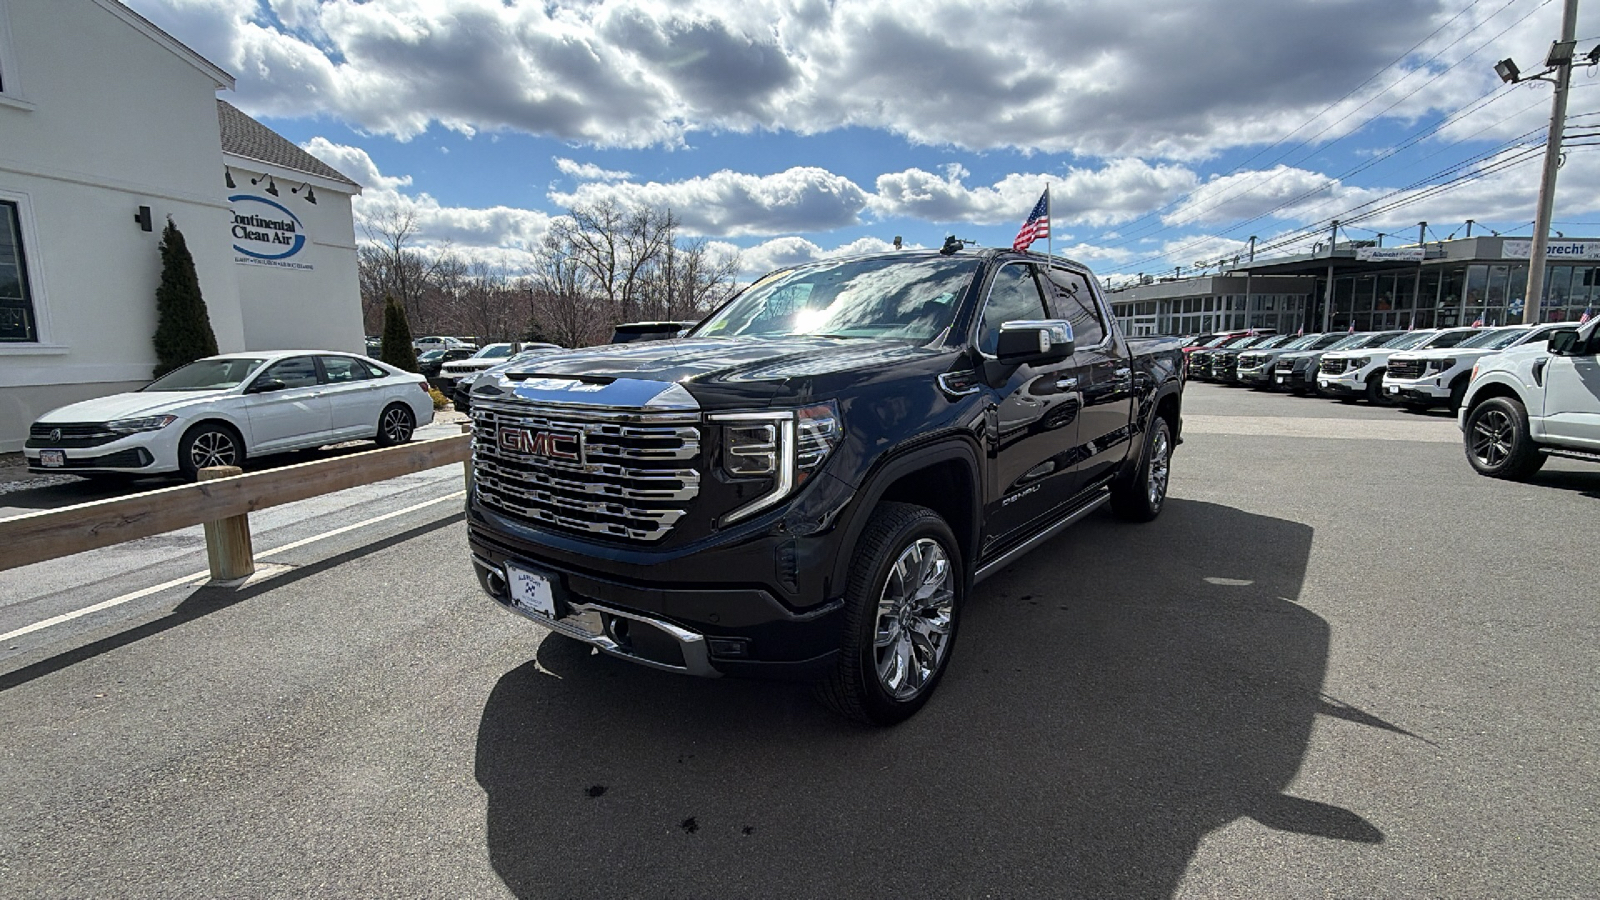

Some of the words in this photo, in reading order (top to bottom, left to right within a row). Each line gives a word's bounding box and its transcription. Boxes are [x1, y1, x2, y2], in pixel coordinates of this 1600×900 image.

[231, 224, 270, 242] Clean
[272, 231, 292, 245] Air
[1546, 243, 1585, 254] recht
[499, 426, 579, 460] GMC
